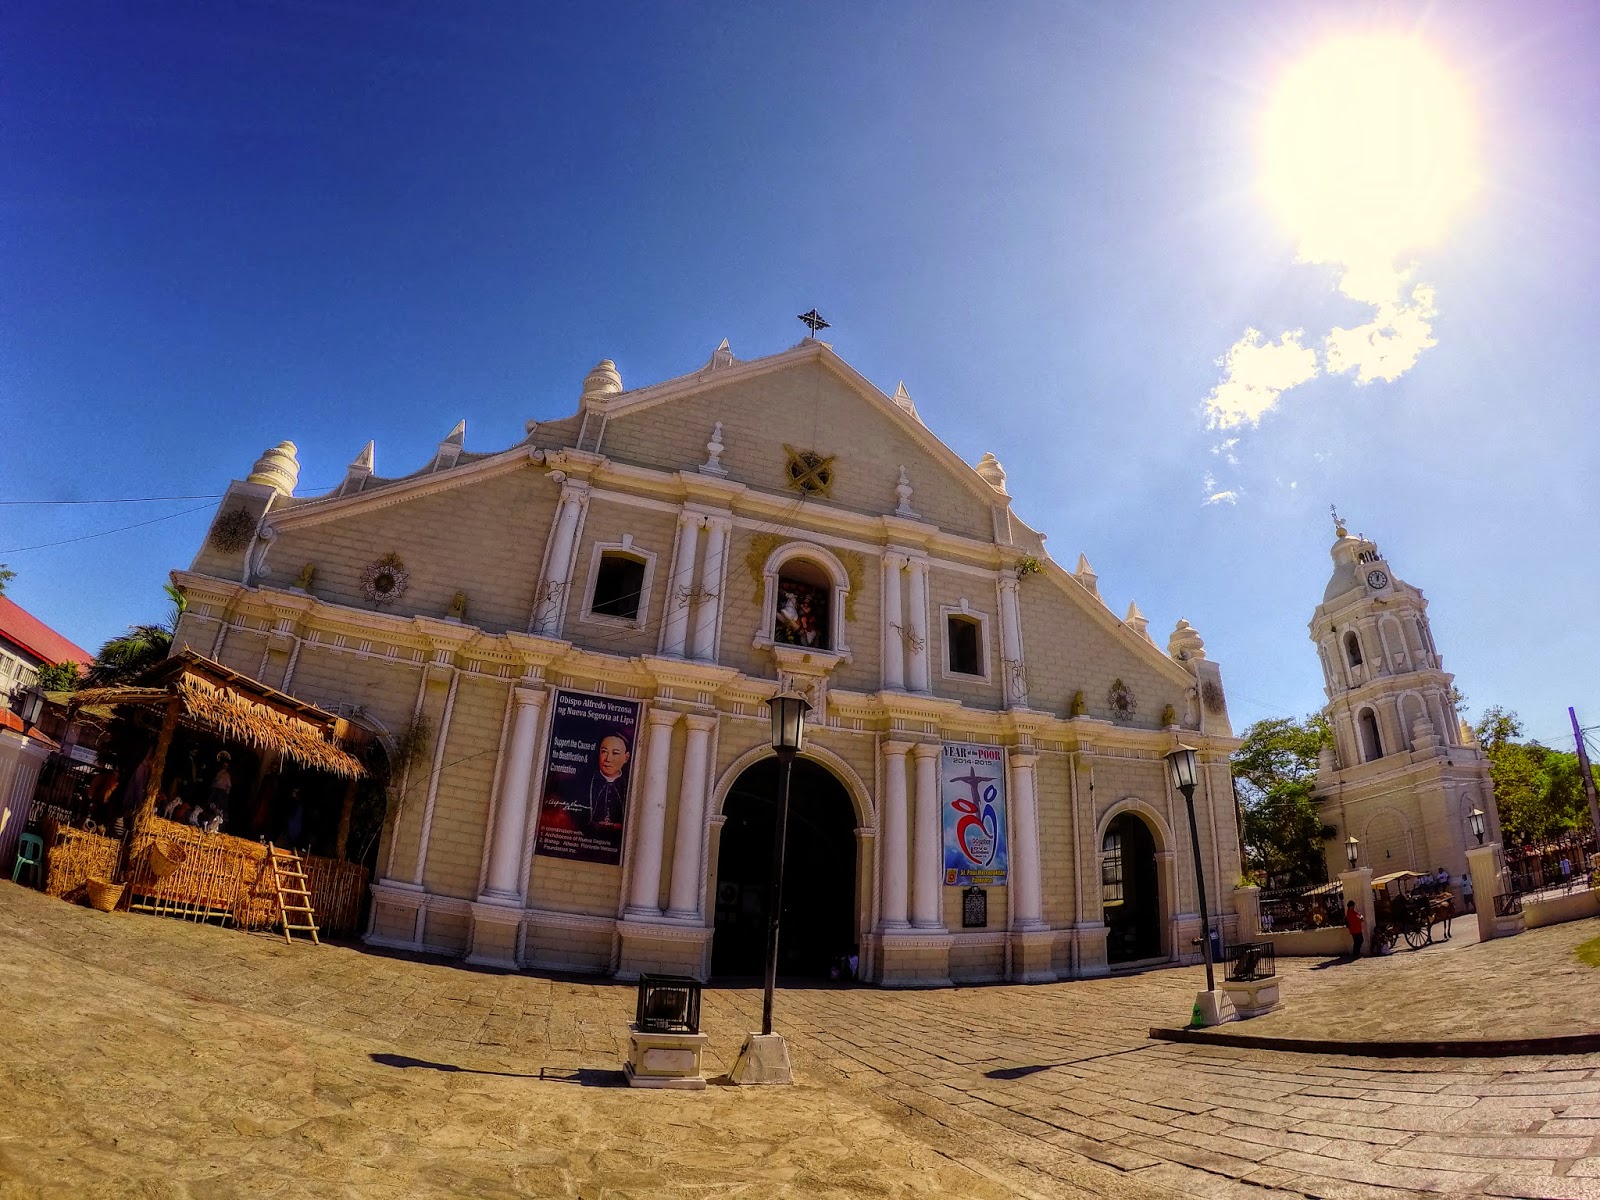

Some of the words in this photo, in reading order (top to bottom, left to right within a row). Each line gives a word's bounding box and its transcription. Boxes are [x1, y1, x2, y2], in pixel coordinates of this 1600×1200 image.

[560, 696, 582, 707] Obispo
[583, 699, 606, 710] Alfredo
[608, 702, 632, 714] Verzosa
[558, 706, 566, 716] ng
[567, 706, 586, 717] Nueva
[587, 710, 611, 721] Segovia
[620, 715, 634, 725] Lipa
[554, 736, 570, 748] Support
[578, 740, 590, 750] Cause
[591, 742, 596, 751] of
[559, 750, 584, 762] Beatification
[584, 754, 588, 763] &
[944, 746, 967, 758] YEAR
[978, 749, 1000, 760] POOR
[550, 762, 576, 774] Canonization
